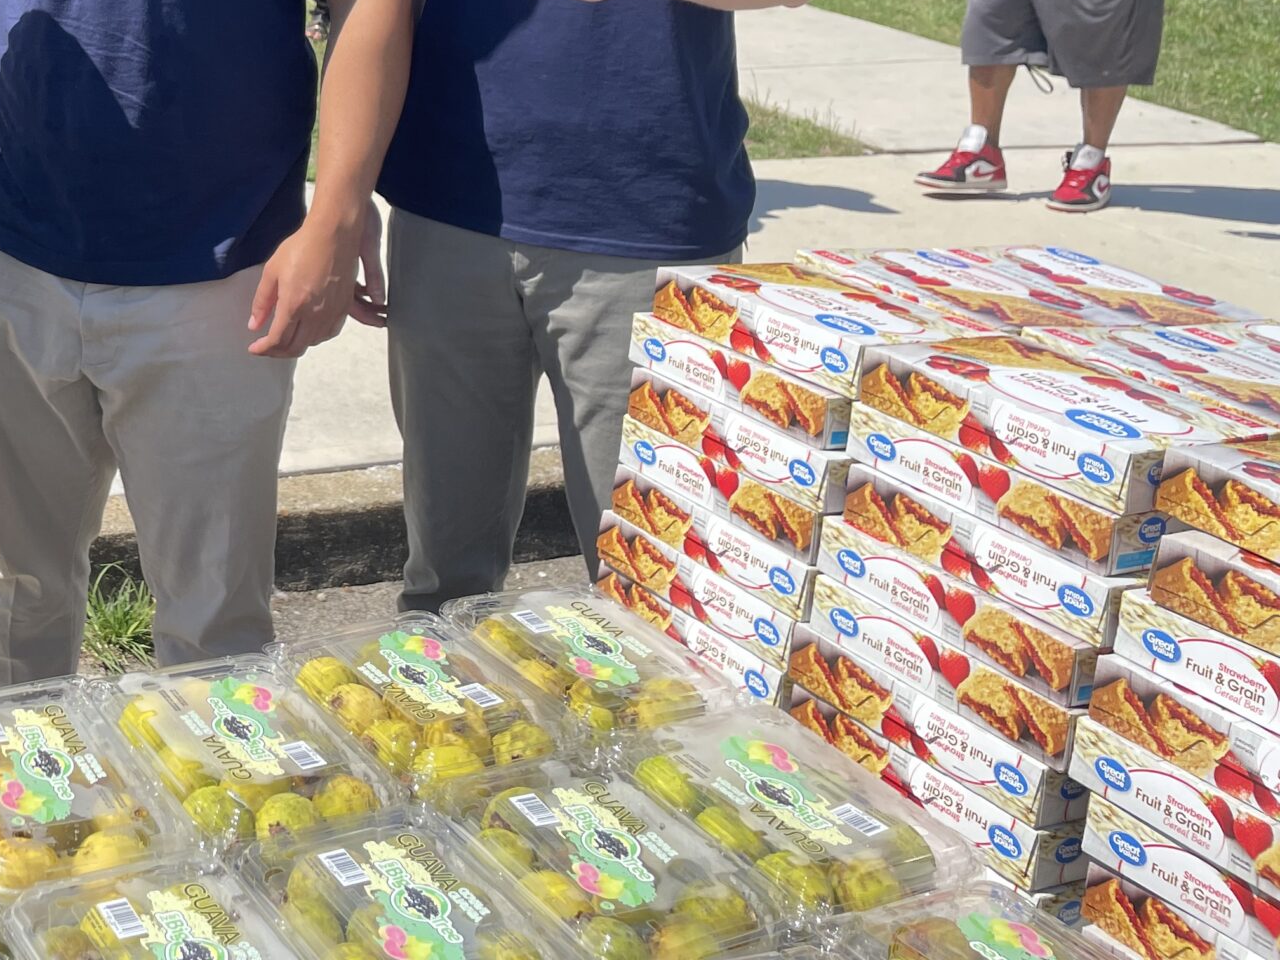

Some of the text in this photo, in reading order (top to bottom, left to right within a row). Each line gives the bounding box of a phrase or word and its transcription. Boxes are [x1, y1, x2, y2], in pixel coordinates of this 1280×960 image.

[1007, 422, 1076, 461] Fruit & Grain
[899, 455, 962, 492] Fruit & Grain
[924, 457, 963, 480] Strawberry
[893, 576, 930, 602] Strawberry
[988, 549, 1057, 592] Fruit & Grain
[869, 573, 929, 613] Fruit & Grain
[570, 601, 625, 638] GUAVA
[862, 633, 923, 675] Fruit & Grain
[886, 637, 924, 663] Strawberry
[1146, 632, 1175, 653] Great
[1185, 657, 1266, 706] Fruit & Grain
[1214, 686, 1242, 706] Cereal
[1218, 662, 1267, 693] Strawberry
[382, 682, 436, 720] GUAVA
[45, 704, 87, 755] GUAVA
[927, 721, 993, 768] Fruit & Grain
[202, 734, 252, 780] GUAVA
[1098, 760, 1126, 783] Great
[584, 782, 647, 835] GUAVA
[923, 781, 988, 830] Fruit & Grain
[1135, 787, 1212, 840] Fruit & Grain
[1167, 794, 1214, 828] Strawberry
[750, 803, 824, 853] GUAVA
[1113, 834, 1141, 857] Great
[1162, 817, 1189, 838] Cereal
[397, 833, 459, 891] GUAVA
[1151, 862, 1232, 918] Fruit & Grain
[1180, 893, 1208, 915] Cereal
[1183, 870, 1233, 905] Strawberry
[184, 883, 241, 945] GUAVA
